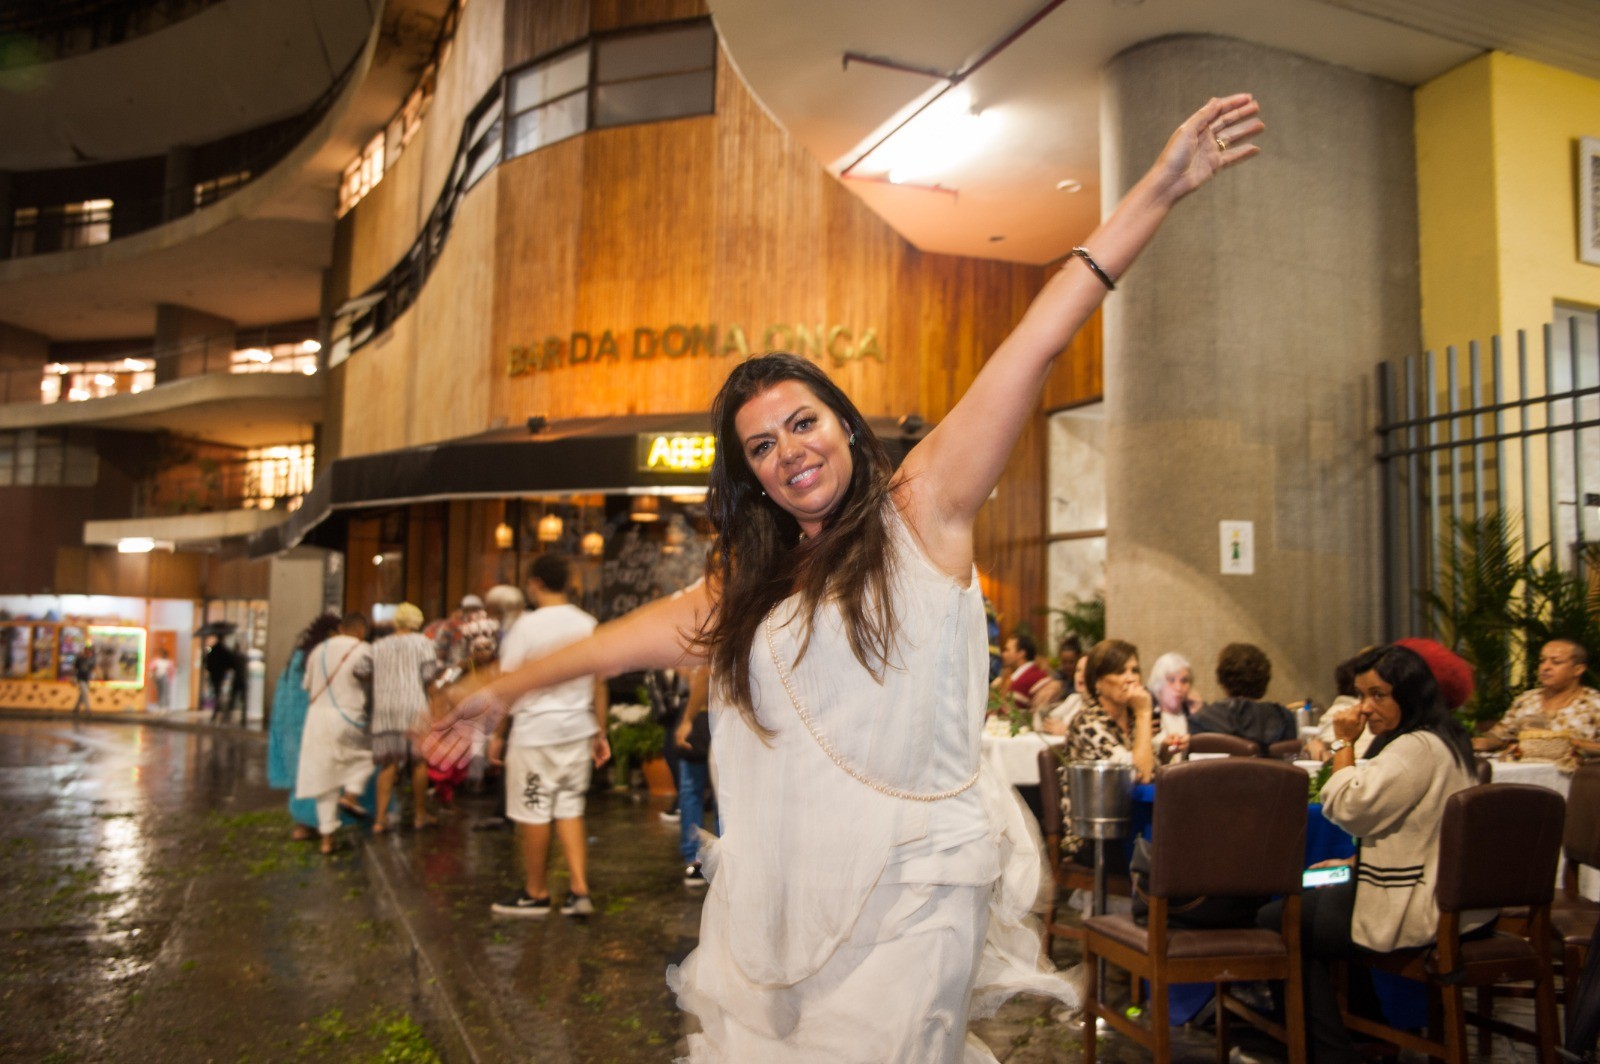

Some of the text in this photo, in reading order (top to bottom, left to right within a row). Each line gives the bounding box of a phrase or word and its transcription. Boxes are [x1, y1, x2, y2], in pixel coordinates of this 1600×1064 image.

[508, 323, 883, 378] BAR DA DONA ONÇA
[647, 435, 716, 470] ABER
